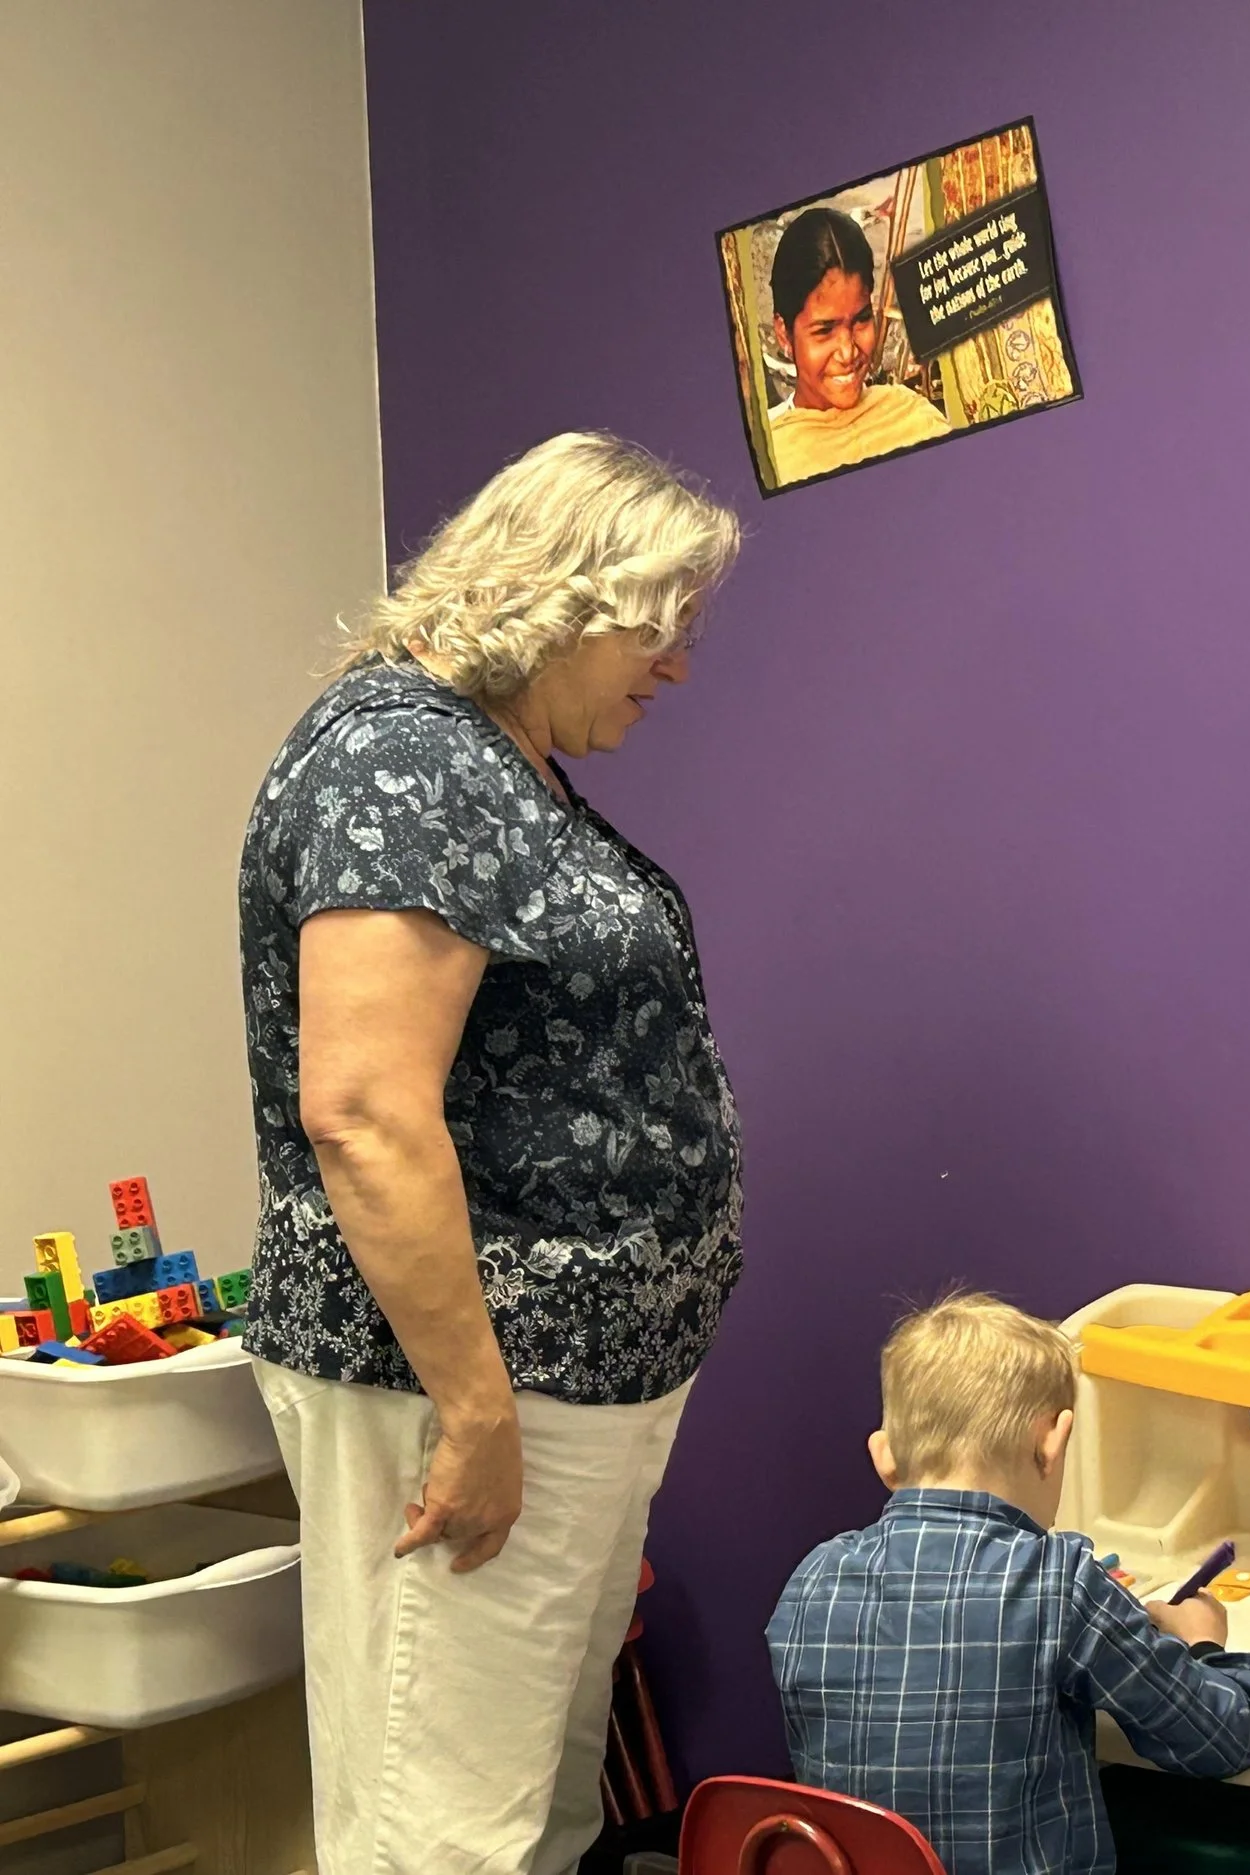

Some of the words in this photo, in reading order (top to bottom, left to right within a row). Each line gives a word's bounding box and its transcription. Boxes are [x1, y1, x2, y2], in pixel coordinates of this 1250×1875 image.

[919, 259, 934, 279] Let
[933, 251, 948, 271] the
[948, 236, 974, 261] whole
[973, 220, 998, 247] world
[998, 212, 1018, 234] sing
[920, 284, 932, 304] for
[948, 258, 980, 286] because
[930, 304, 946, 325] the
[945, 288, 976, 316] nations
[976, 278, 986, 299] of
[985, 273, 1001, 294] the
[1001, 258, 1028, 285] earth.
